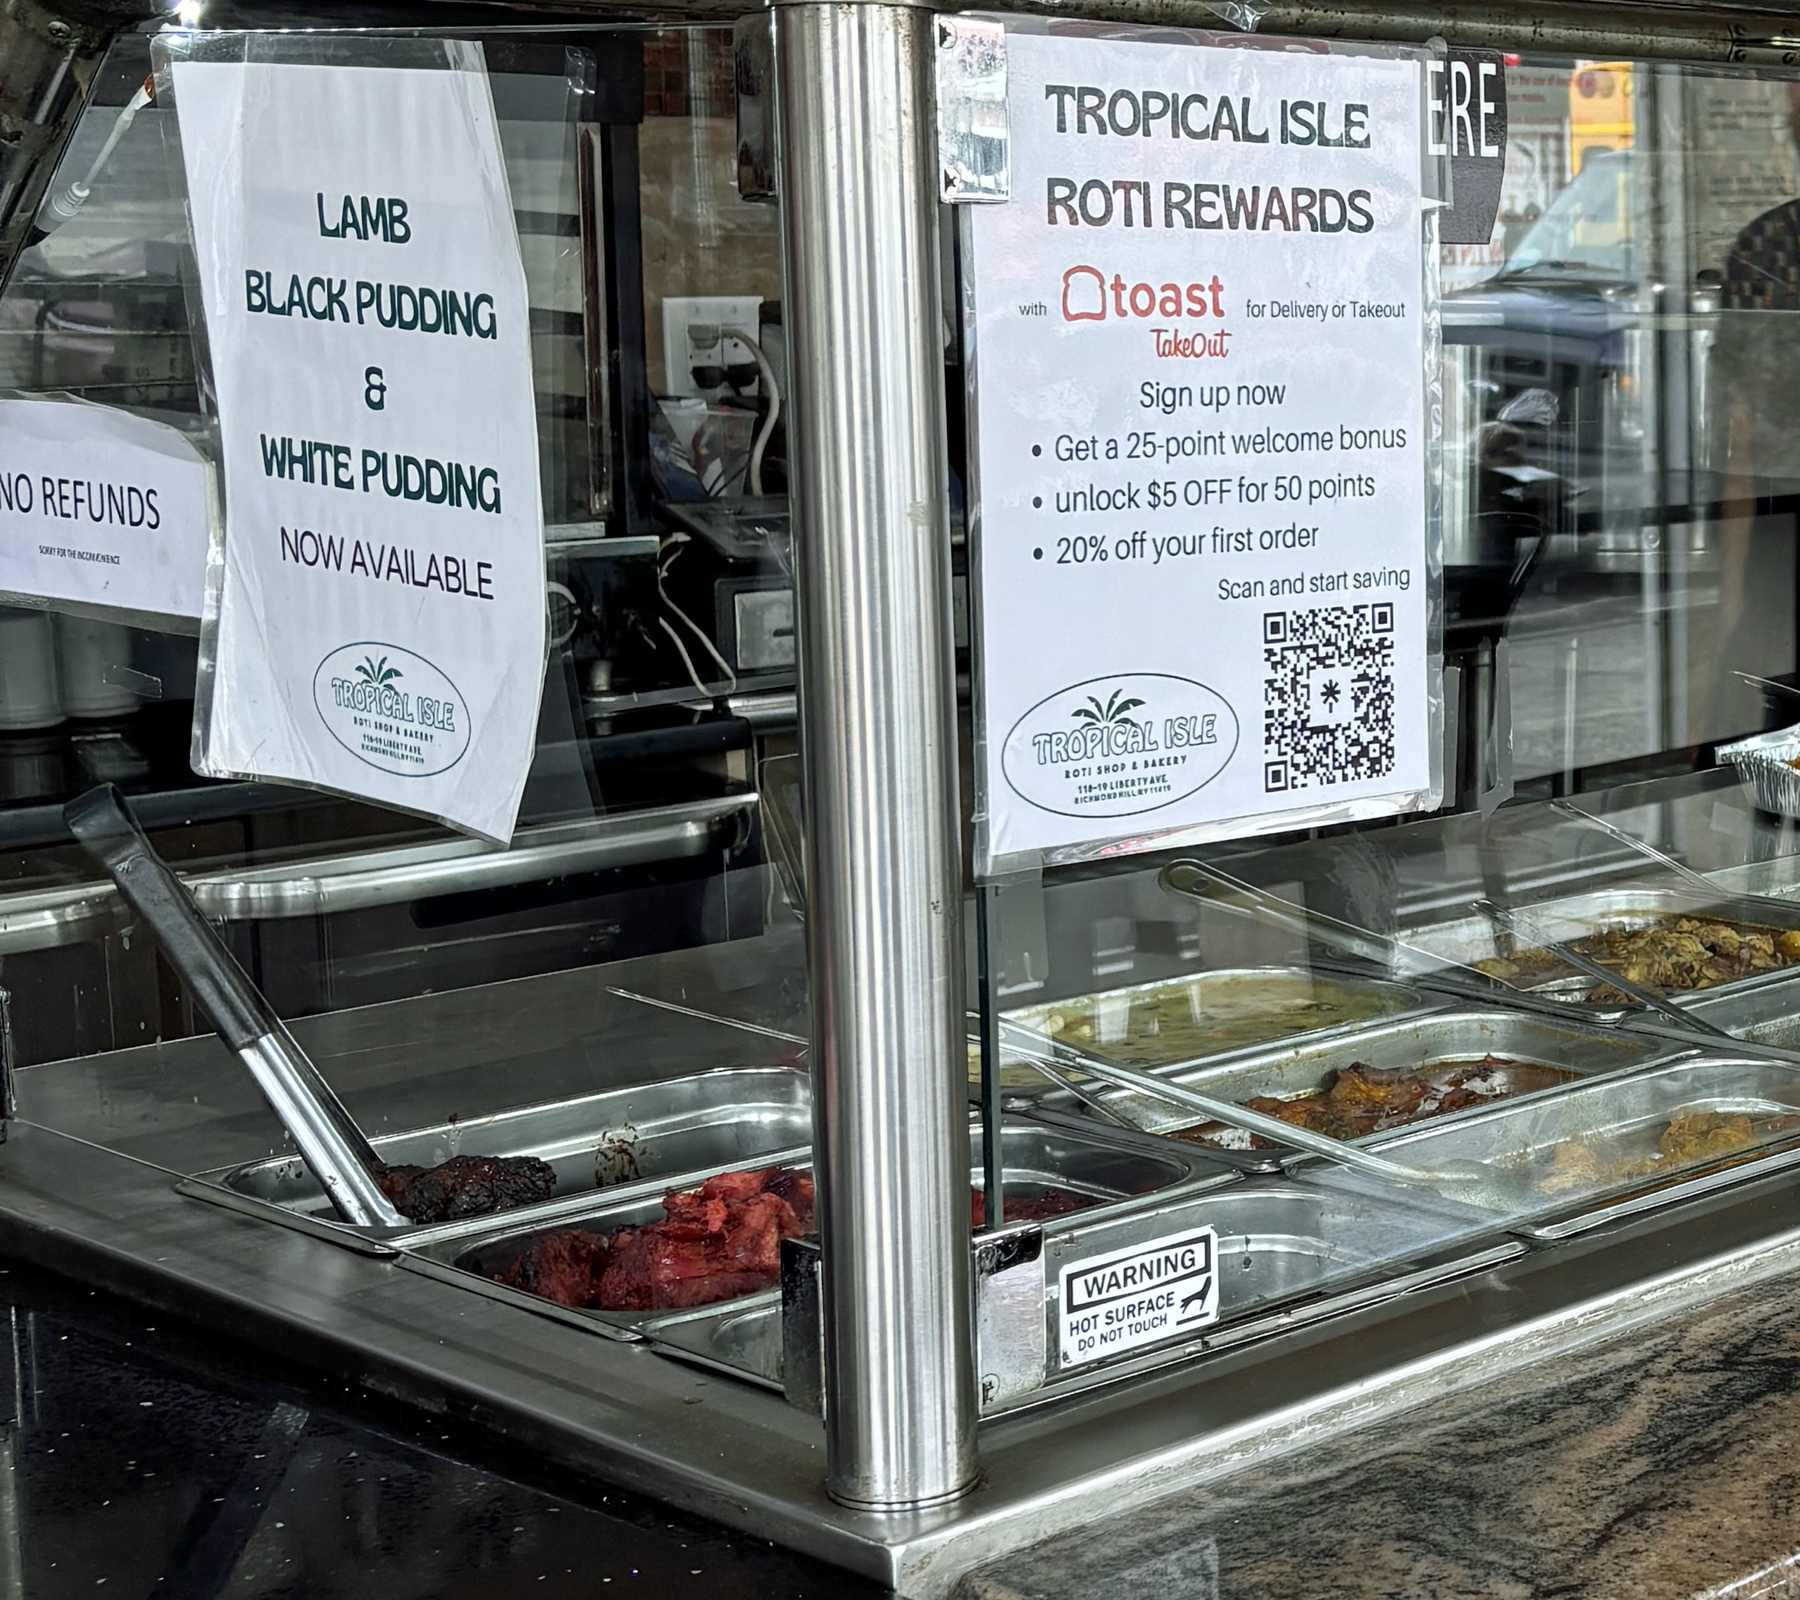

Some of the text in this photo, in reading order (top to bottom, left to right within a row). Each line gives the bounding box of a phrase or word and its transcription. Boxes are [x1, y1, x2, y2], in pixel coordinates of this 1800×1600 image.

[1045, 84, 1372, 149] TROPICAL ISLE
[317, 192, 411, 244] LAMB
[1046, 177, 1375, 234] ROTI REWARDS
[245, 269, 497, 340] BLACK PUDDING
[1019, 274, 1405, 323] with toast for Delivery or Takeout
[1149, 328, 1233, 359] TakeOut
[365, 366, 386, 410] &
[1139, 381, 1286, 415] Sign up now
[1054, 423, 1407, 463] Get a 25-point welcome bonus
[260, 433, 502, 514] WHITE PUDDING
[1055, 473, 1375, 513] unlock $5 OFF for 50 points
[0, 472, 161, 530] NO REFUNDS
[280, 526, 494, 600] NOW AVAILABLE
[1056, 521, 1319, 564] 20% off your first order
[1218, 567, 1411, 601] Scan and start saving
[332, 677, 455, 732] TROPICAL ISLE
[403, 729, 434, 743] BAKERY
[1032, 714, 1217, 765] TROPICAL ISLE
[1065, 755, 1188, 779] ROTI SHOP & BAKERY
[1110, 777, 1148, 791] LIBERTY
[1084, 1249, 1195, 1298] WARNING
[1070, 1291, 1175, 1337] HOT SURFACE
[1078, 1314, 1167, 1351] DO NOT TOUCH
